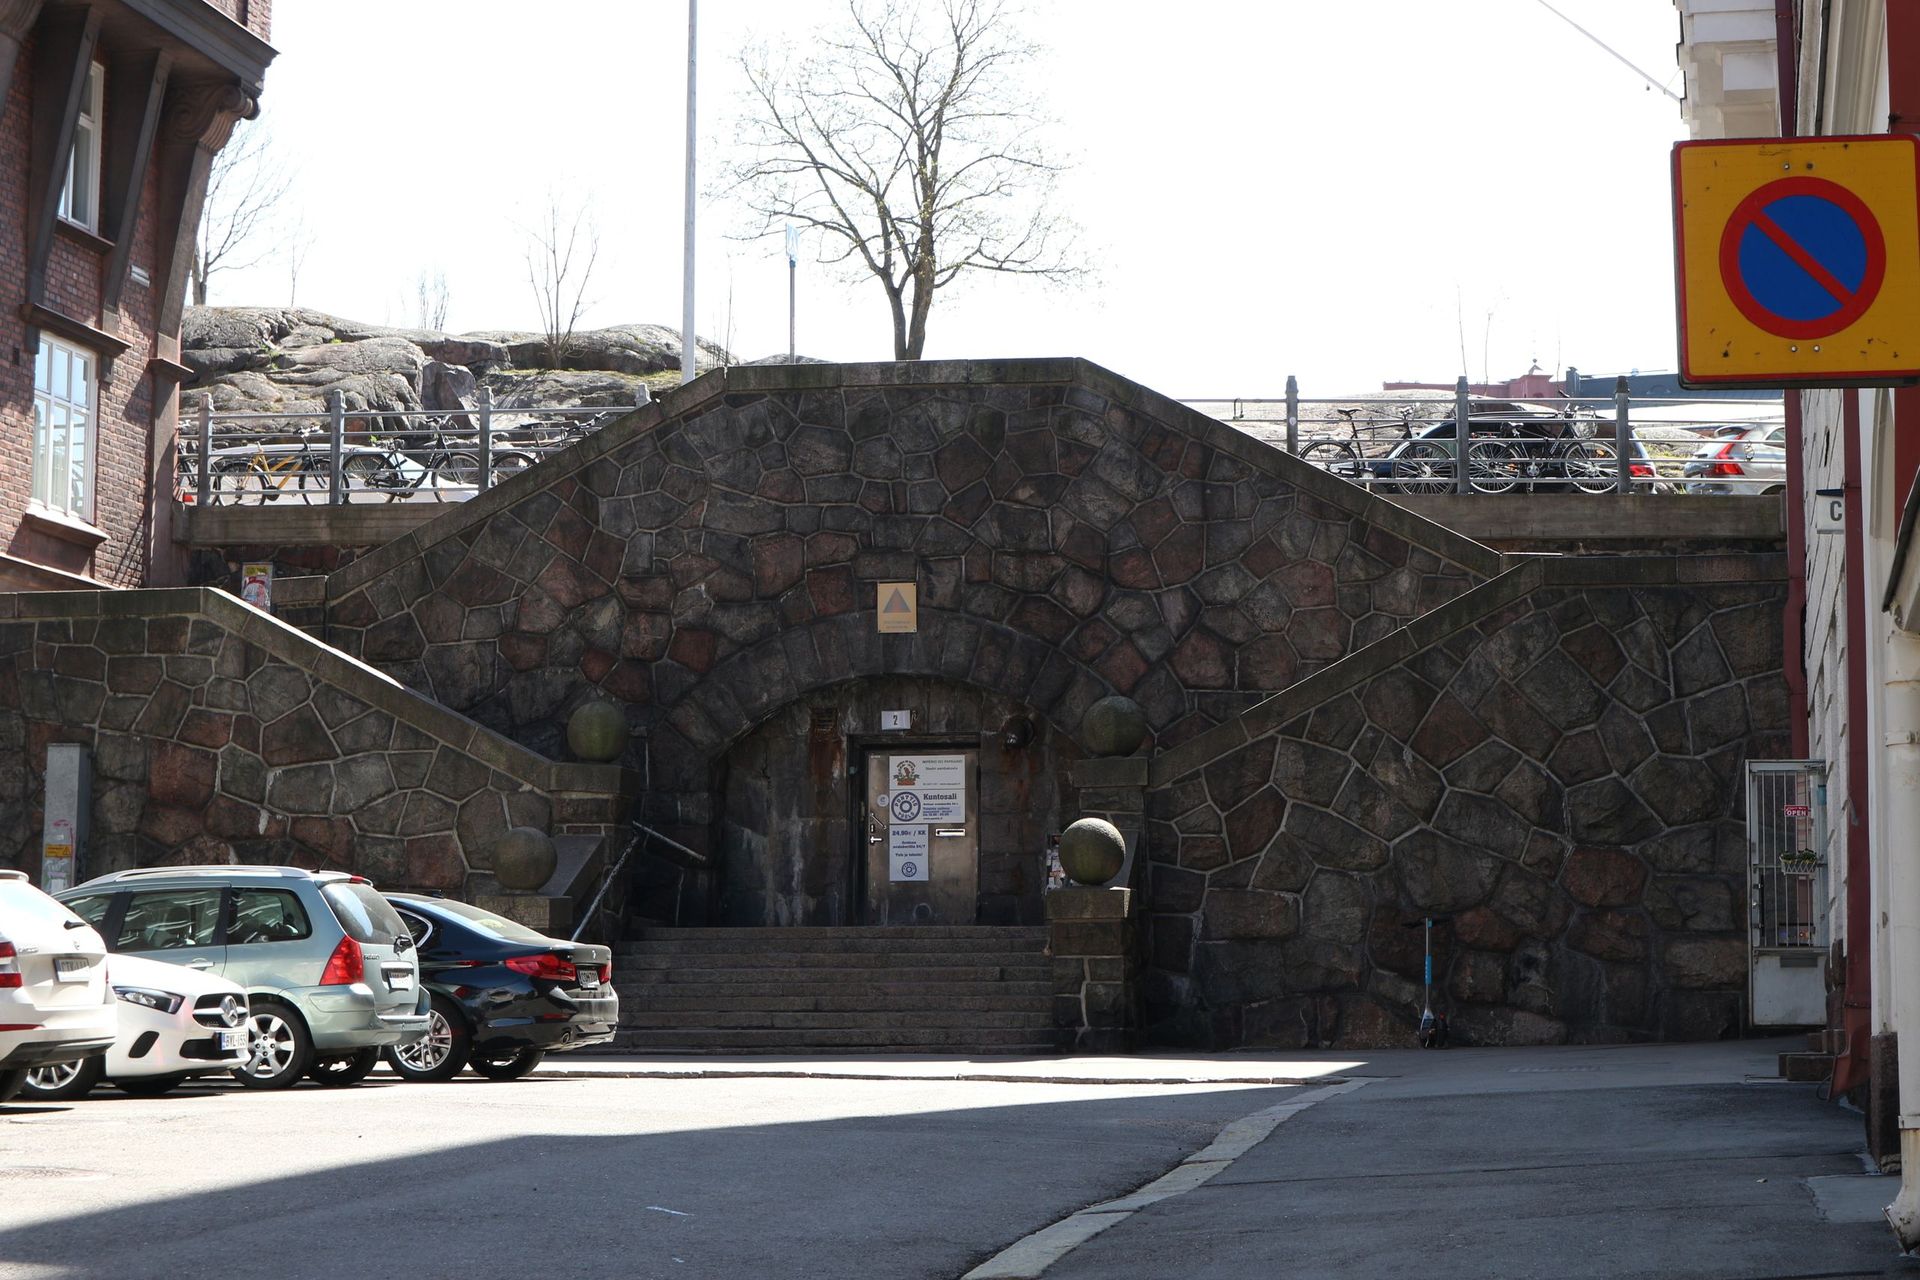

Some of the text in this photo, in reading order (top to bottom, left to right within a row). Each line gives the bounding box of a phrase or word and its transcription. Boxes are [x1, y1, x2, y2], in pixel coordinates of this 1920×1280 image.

[1830, 500, 1843, 522] C
[893, 714, 898, 726] 2
[923, 793, 957, 801] Kuntosali
